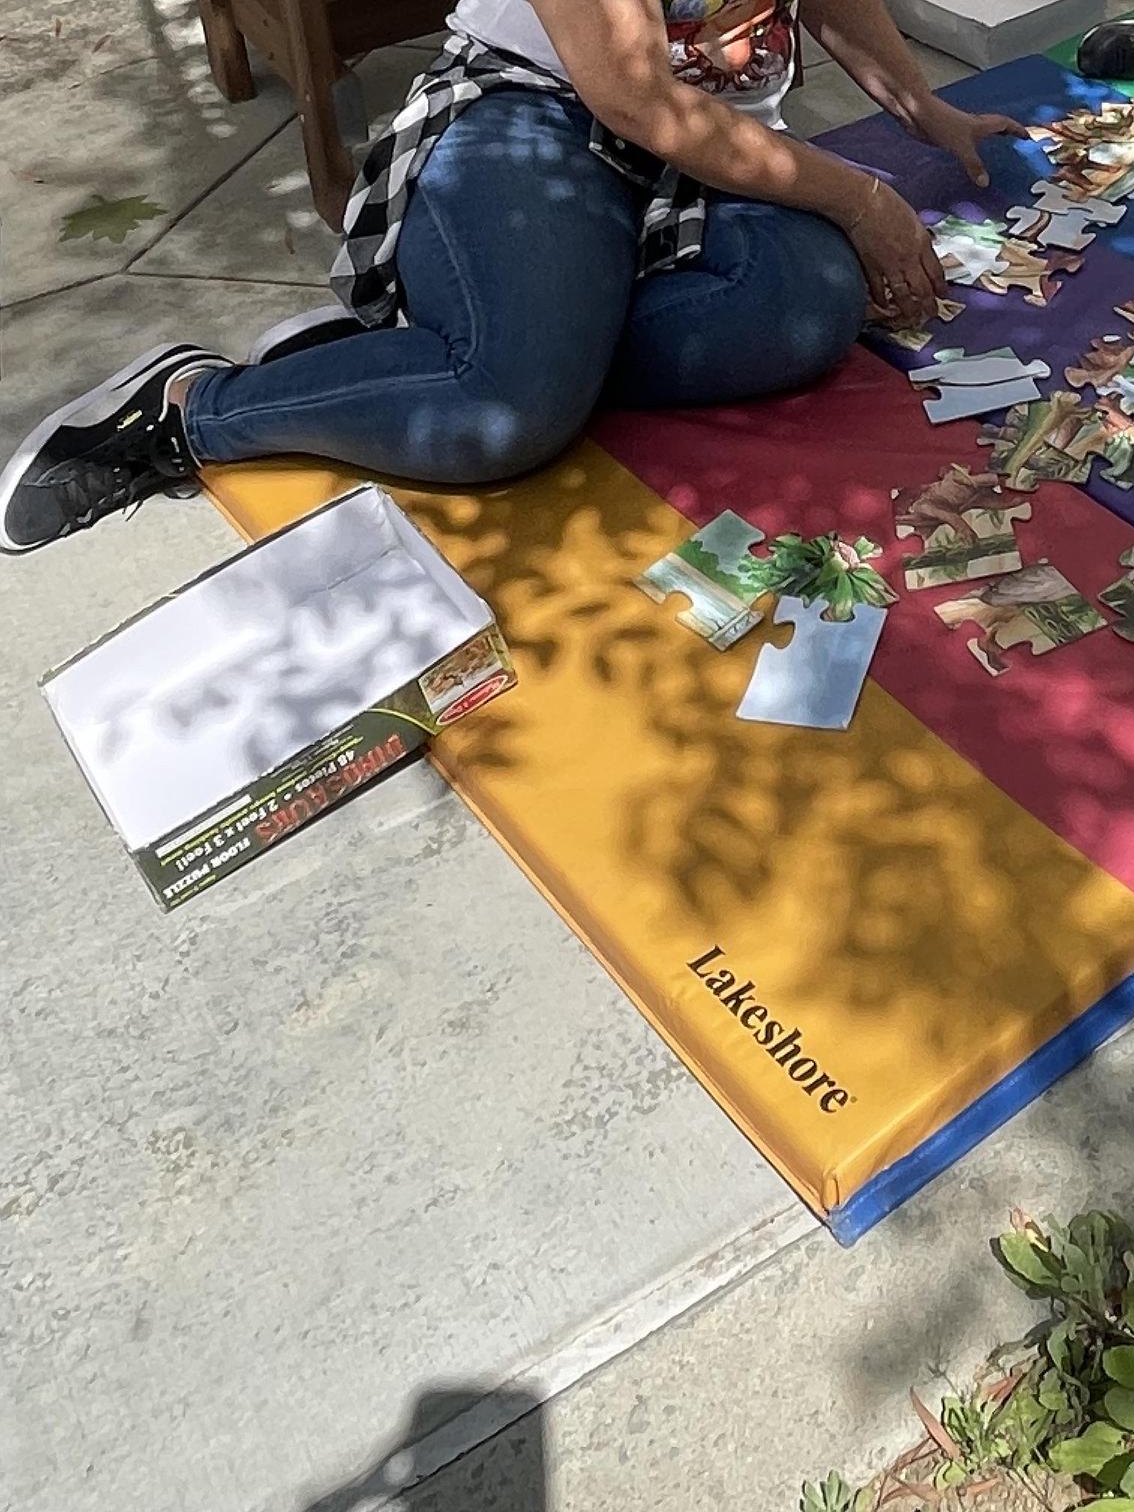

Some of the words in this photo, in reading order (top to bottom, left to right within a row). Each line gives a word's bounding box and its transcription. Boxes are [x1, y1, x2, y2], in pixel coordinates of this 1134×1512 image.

[257, 734, 406, 843] DINOSAURS
[293, 760, 338, 793] Pieces
[234, 806, 267, 833] Feet
[266, 798, 279, 812] 2
[209, 836, 251, 868] FLOOR
[211, 833, 225, 848] 3
[162, 862, 210, 899] PUZZLE
[686, 944, 849, 1114] Lakeshore
